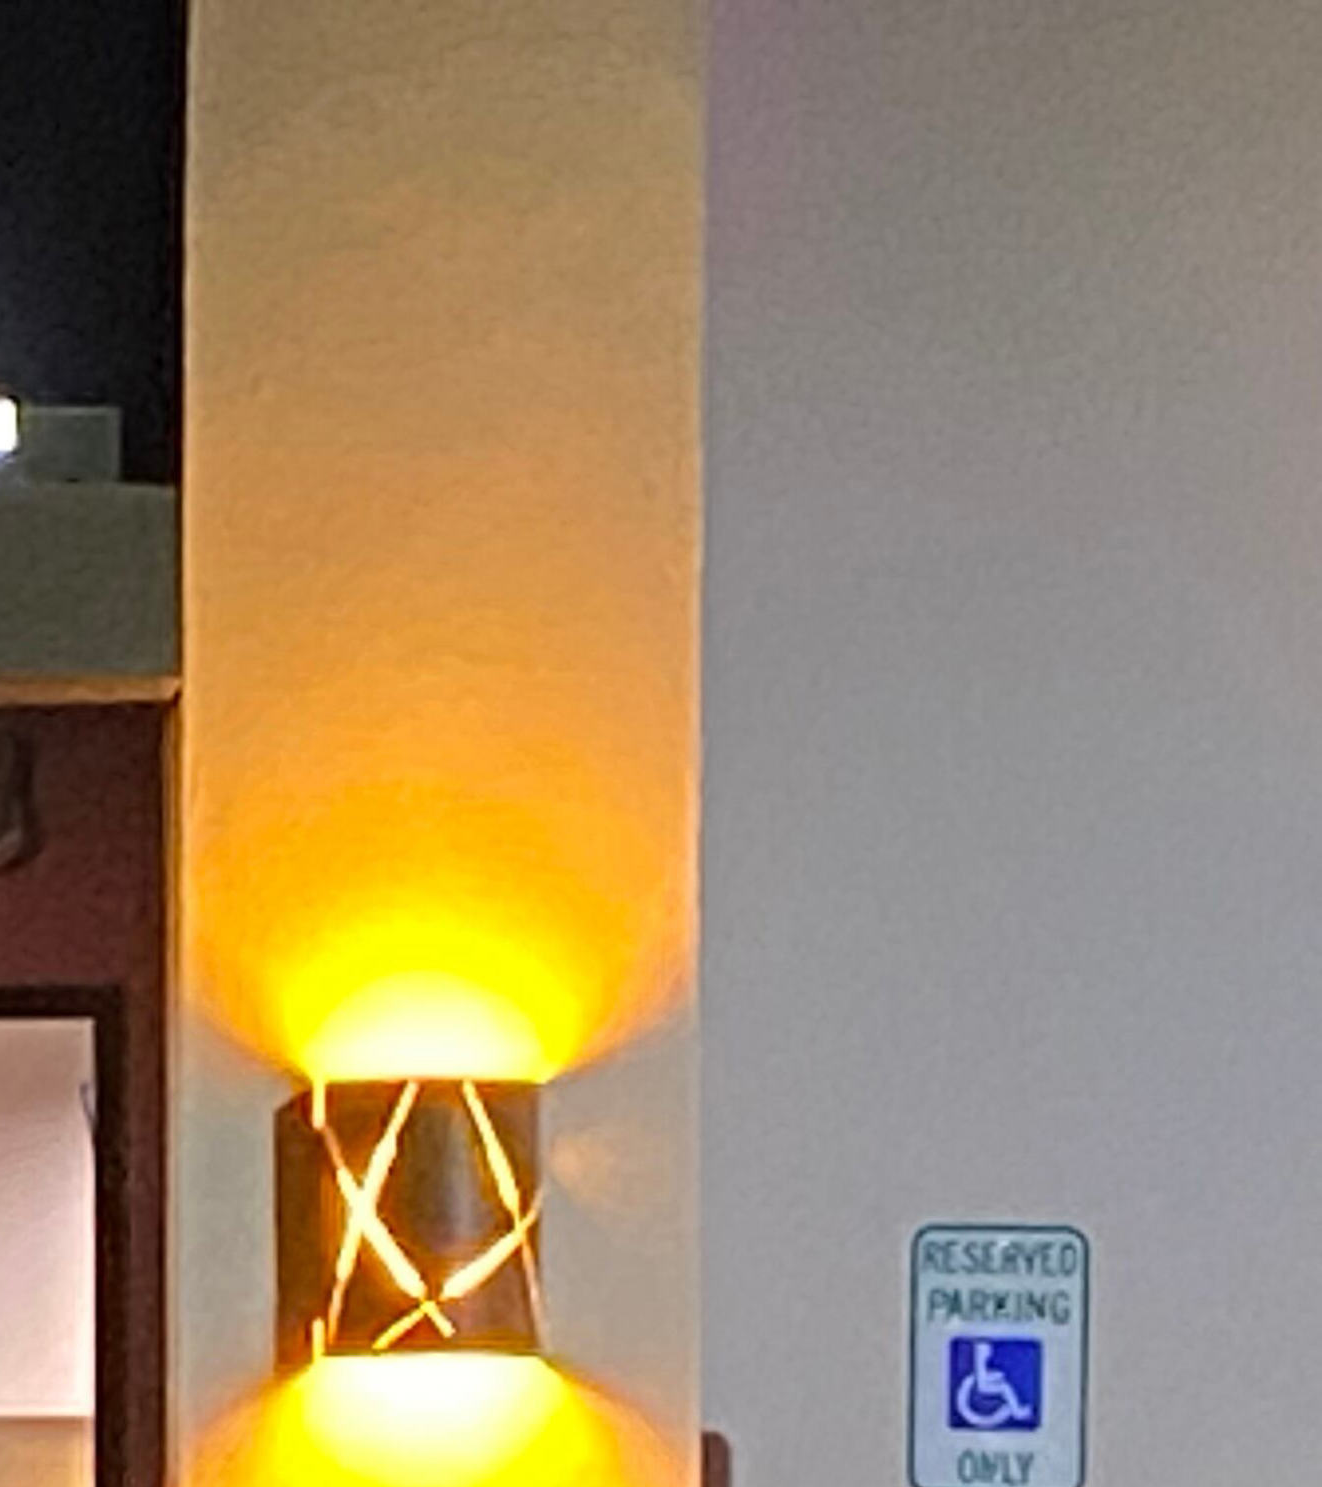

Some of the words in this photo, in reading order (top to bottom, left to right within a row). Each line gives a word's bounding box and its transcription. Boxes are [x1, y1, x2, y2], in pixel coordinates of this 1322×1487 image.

[922, 1240, 1078, 1277] RESERVED
[926, 1289, 1071, 1326] PARKING
[957, 1449, 1035, 1487] ONLY
